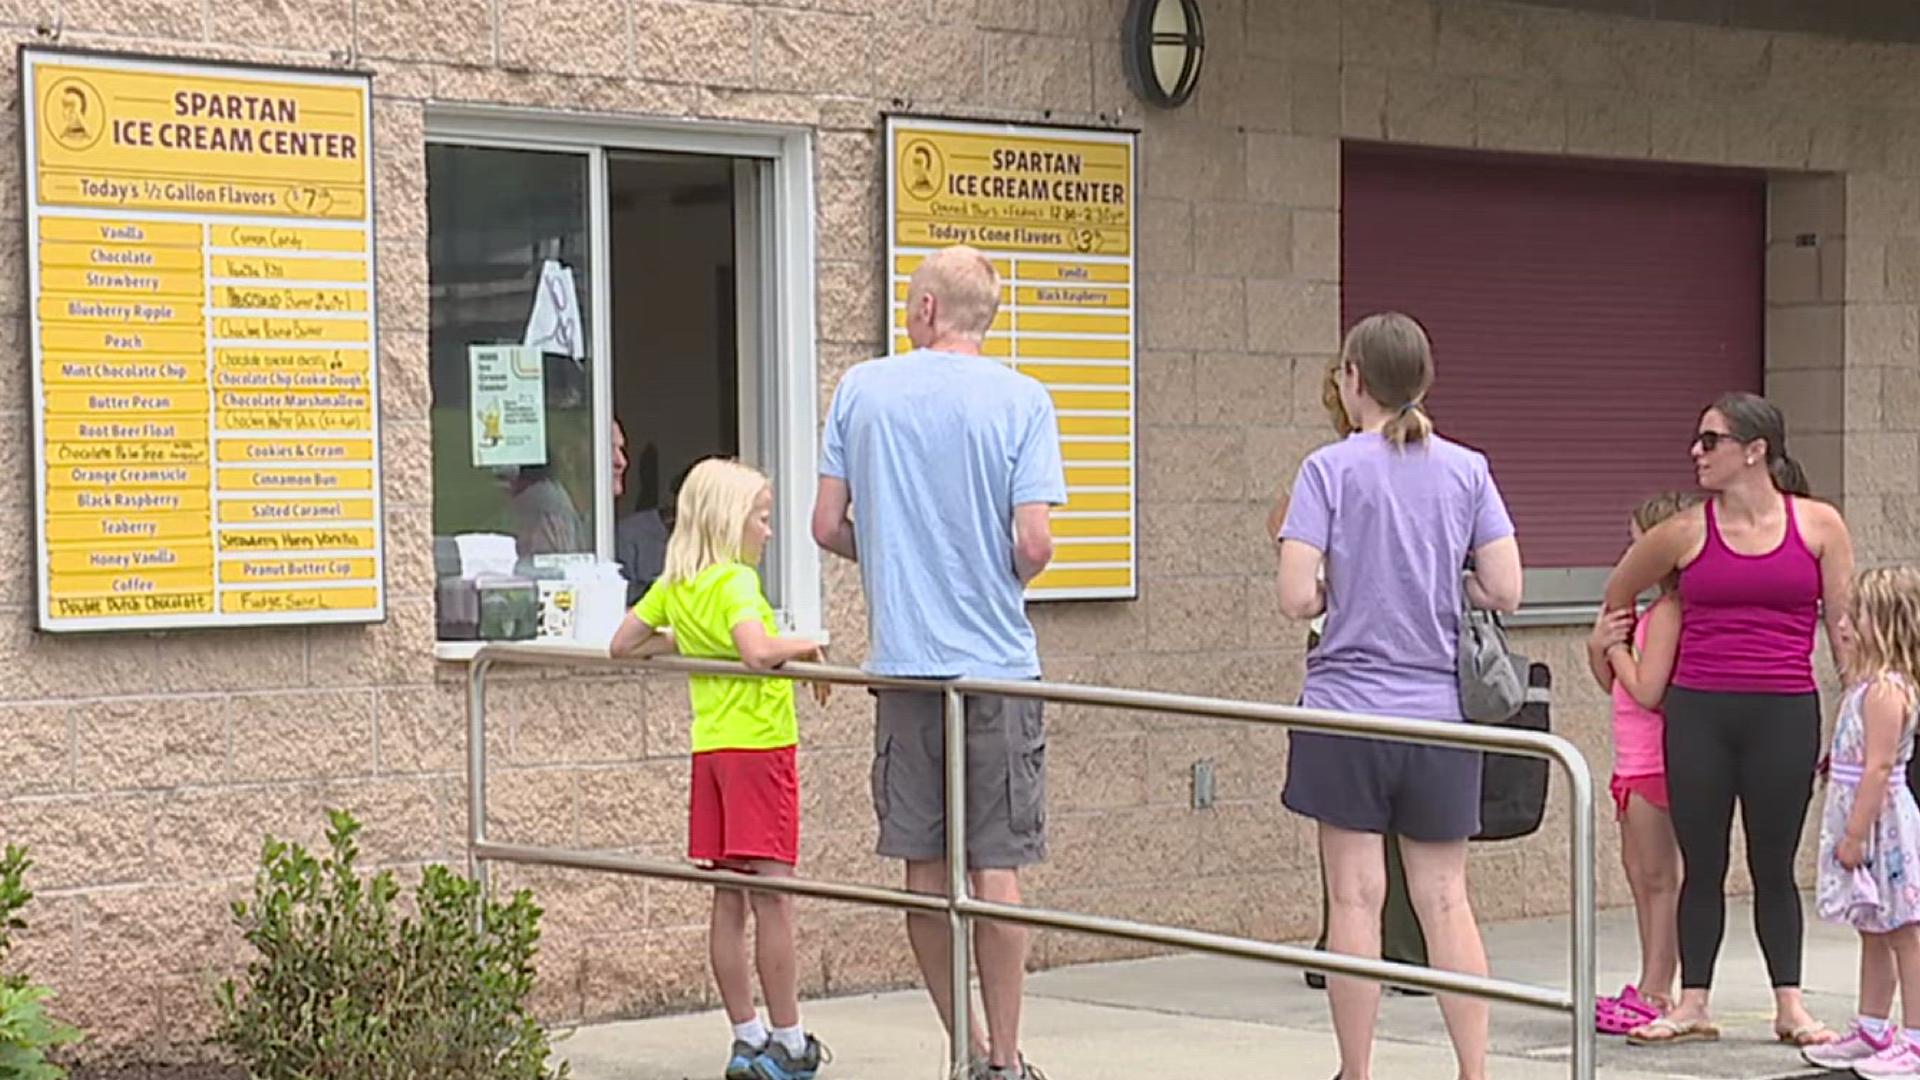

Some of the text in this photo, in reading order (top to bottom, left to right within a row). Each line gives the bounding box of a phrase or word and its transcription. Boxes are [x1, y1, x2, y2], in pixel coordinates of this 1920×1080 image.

[174, 91, 296, 123] SPARTAN
[113, 119, 357, 159] ICE CREAM CENTER
[992, 148, 1081, 175] SPARTAN
[80, 178, 138, 203] Today's
[165, 183, 215, 202] Gallon
[219, 186, 276, 206] Flavors
[949, 173, 1124, 204] ICE CREAM CENTER
[101, 226, 144, 239] Vanilla
[929, 223, 976, 245] Today's
[979, 226, 1011, 242] Cone
[1013, 227, 1062, 245] Flavors
[90, 249, 152, 263] Chocolate
[86, 272, 159, 290] Strawberry
[1037, 287, 1107, 305] Black Raspberry
[68, 302, 172, 320] Blueberry Ripple
[105, 334, 142, 347] Peach
[62, 364, 187, 379] Mint Chocolate Chip
[218, 373, 362, 389] Chocolate Chip Cookie Dough
[89, 395, 170, 408] Butter Pecan
[223, 394, 365, 406] Chocolate Marshmallow
[79, 424, 175, 436] Root Beer Float
[246, 444, 344, 457] Cookies & Cream
[71, 468, 187, 484] Orange Creamsicle
[252, 473, 337, 486] Cinnamon Bun
[77, 493, 179, 508] Black Raspberry
[252, 502, 341, 517] Salted Caramel
[102, 520, 157, 535] Teaberry
[90, 550, 176, 567] Honey Vanilla
[243, 561, 350, 575] Peanut Butter Cup
[112, 577, 154, 591] Coffee
[144, 594, 206, 609] Chocolate
[240, 591, 281, 611] Fudge
